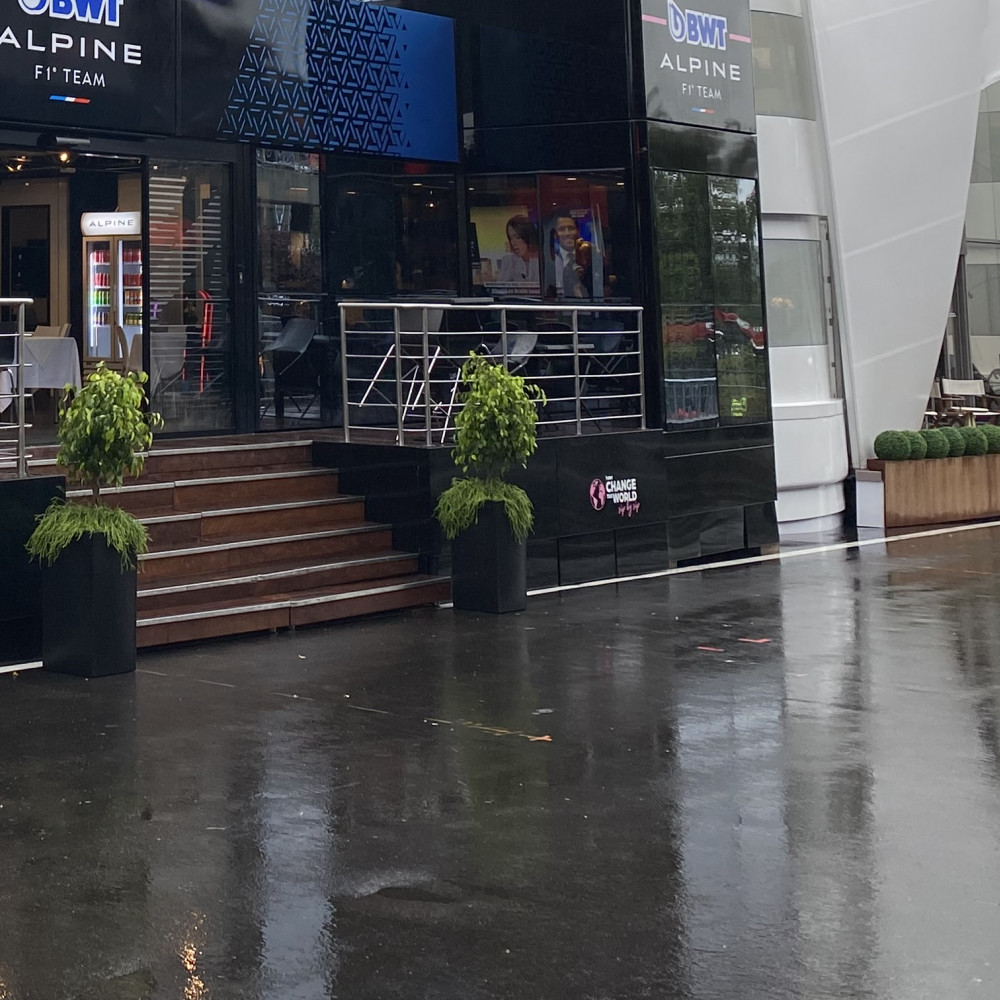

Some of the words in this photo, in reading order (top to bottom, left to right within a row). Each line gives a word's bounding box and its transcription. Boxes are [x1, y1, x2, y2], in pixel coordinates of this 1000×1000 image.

[685, 9, 728, 51] BWT
[660, 52, 741, 81] ALPINE
[62, 68, 106, 87] TEAM
[697, 85, 722, 100] TEAM
[606, 478, 637, 493] CHANGE
[613, 491, 637, 503] WORLD
